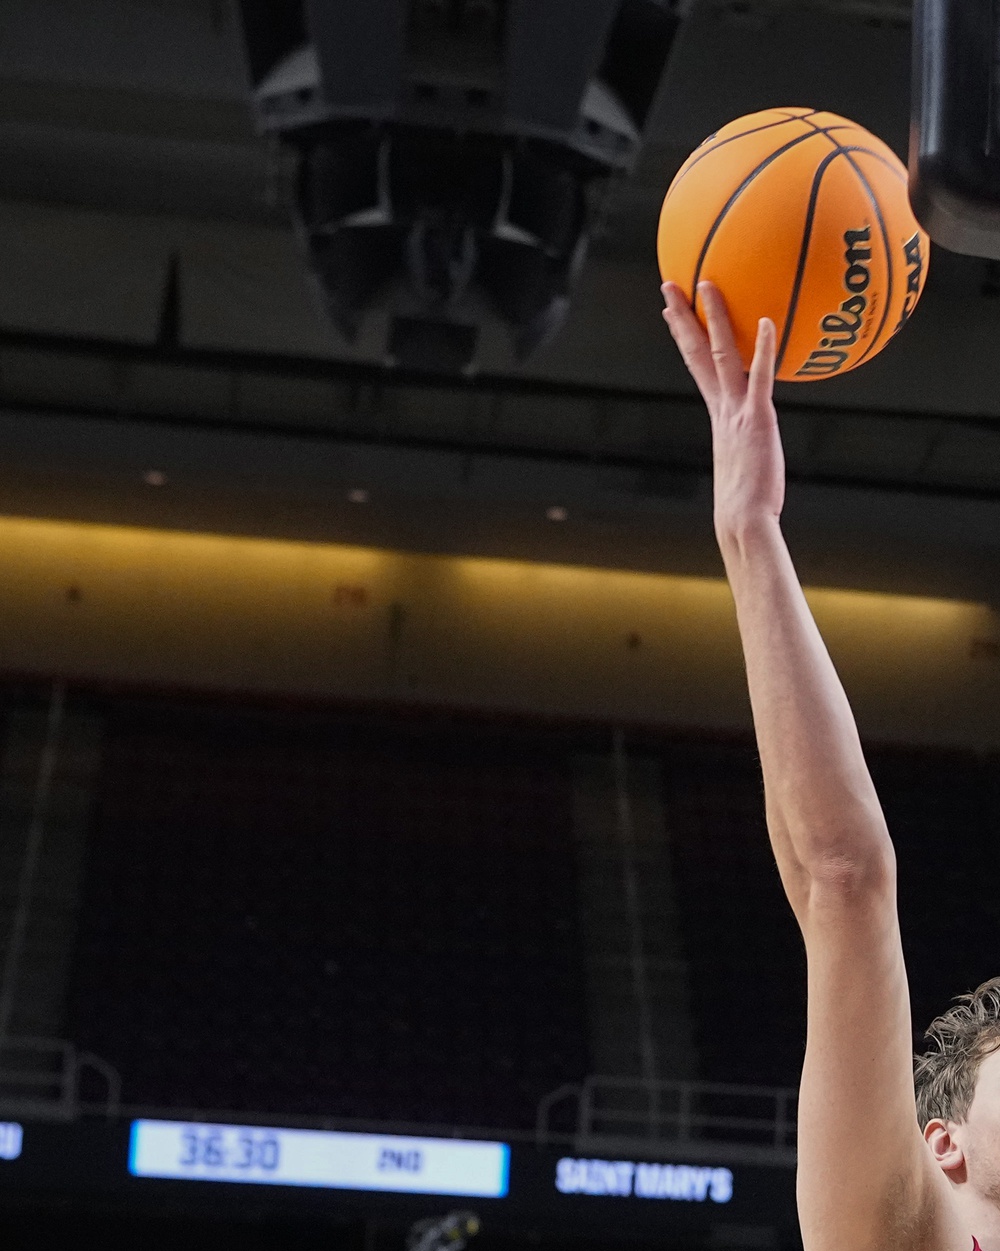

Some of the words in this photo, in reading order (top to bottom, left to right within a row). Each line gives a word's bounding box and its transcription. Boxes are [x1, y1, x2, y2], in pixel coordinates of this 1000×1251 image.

[795, 225, 871, 376] Wilson
[555, 1157, 635, 1197] SAINT
[635, 1162, 734, 1203] MARY'S
